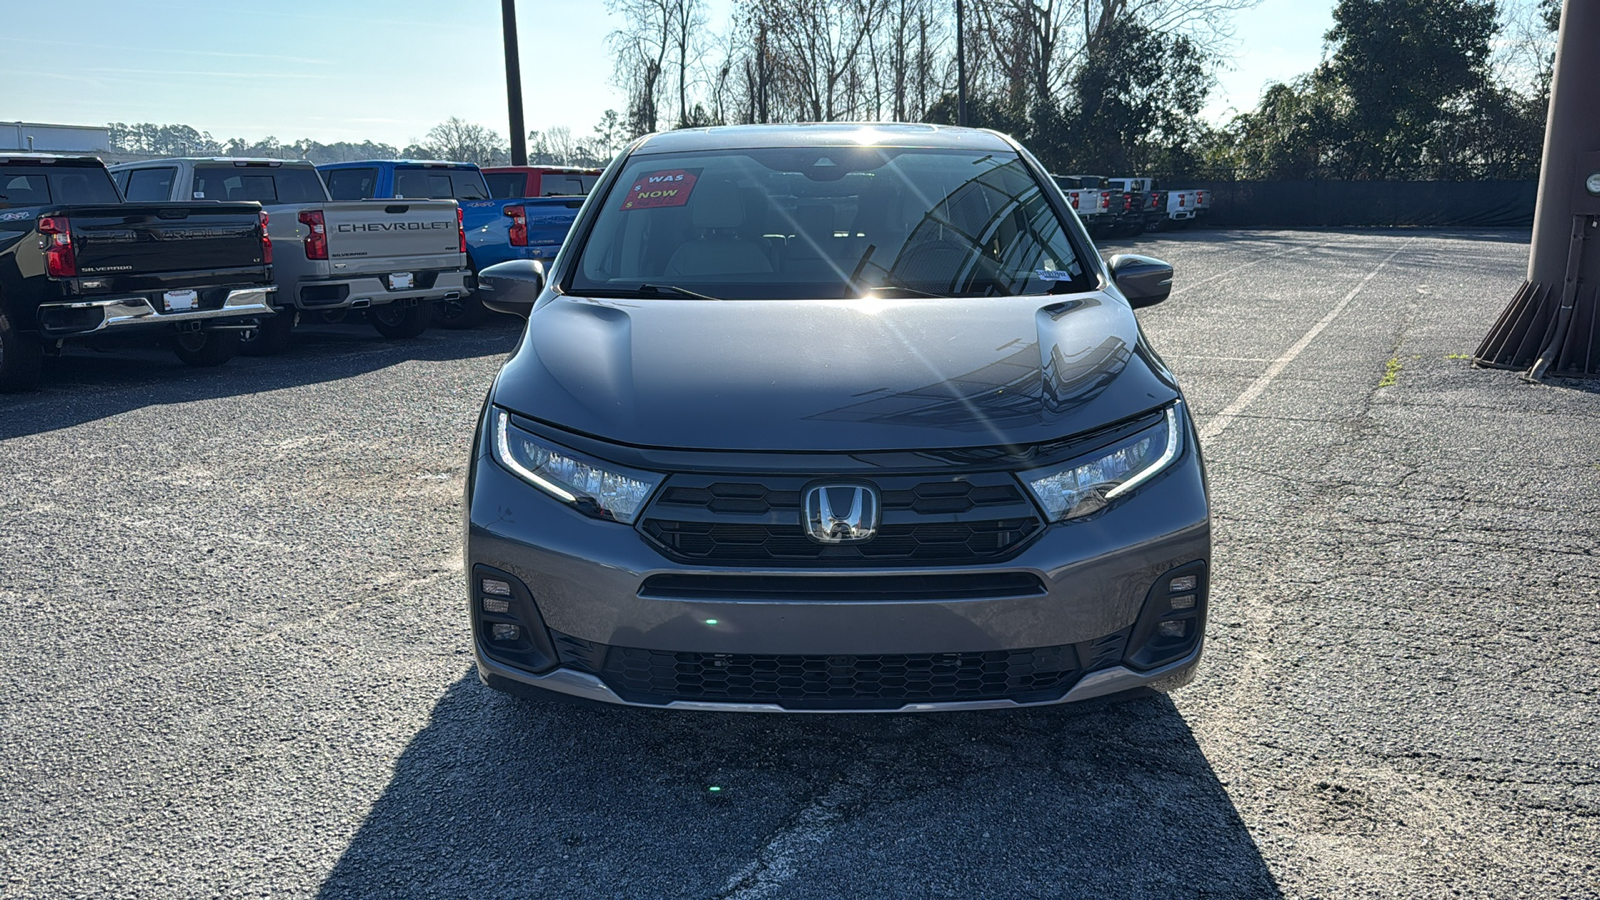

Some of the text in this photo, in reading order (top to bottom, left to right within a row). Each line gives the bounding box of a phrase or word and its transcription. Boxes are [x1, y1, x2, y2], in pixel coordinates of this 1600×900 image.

[648, 174, 684, 183] WAS
[637, 189, 678, 199] NOW
[337, 221, 452, 233] CHEVROLET
[81, 265, 133, 273] SILVERADO
